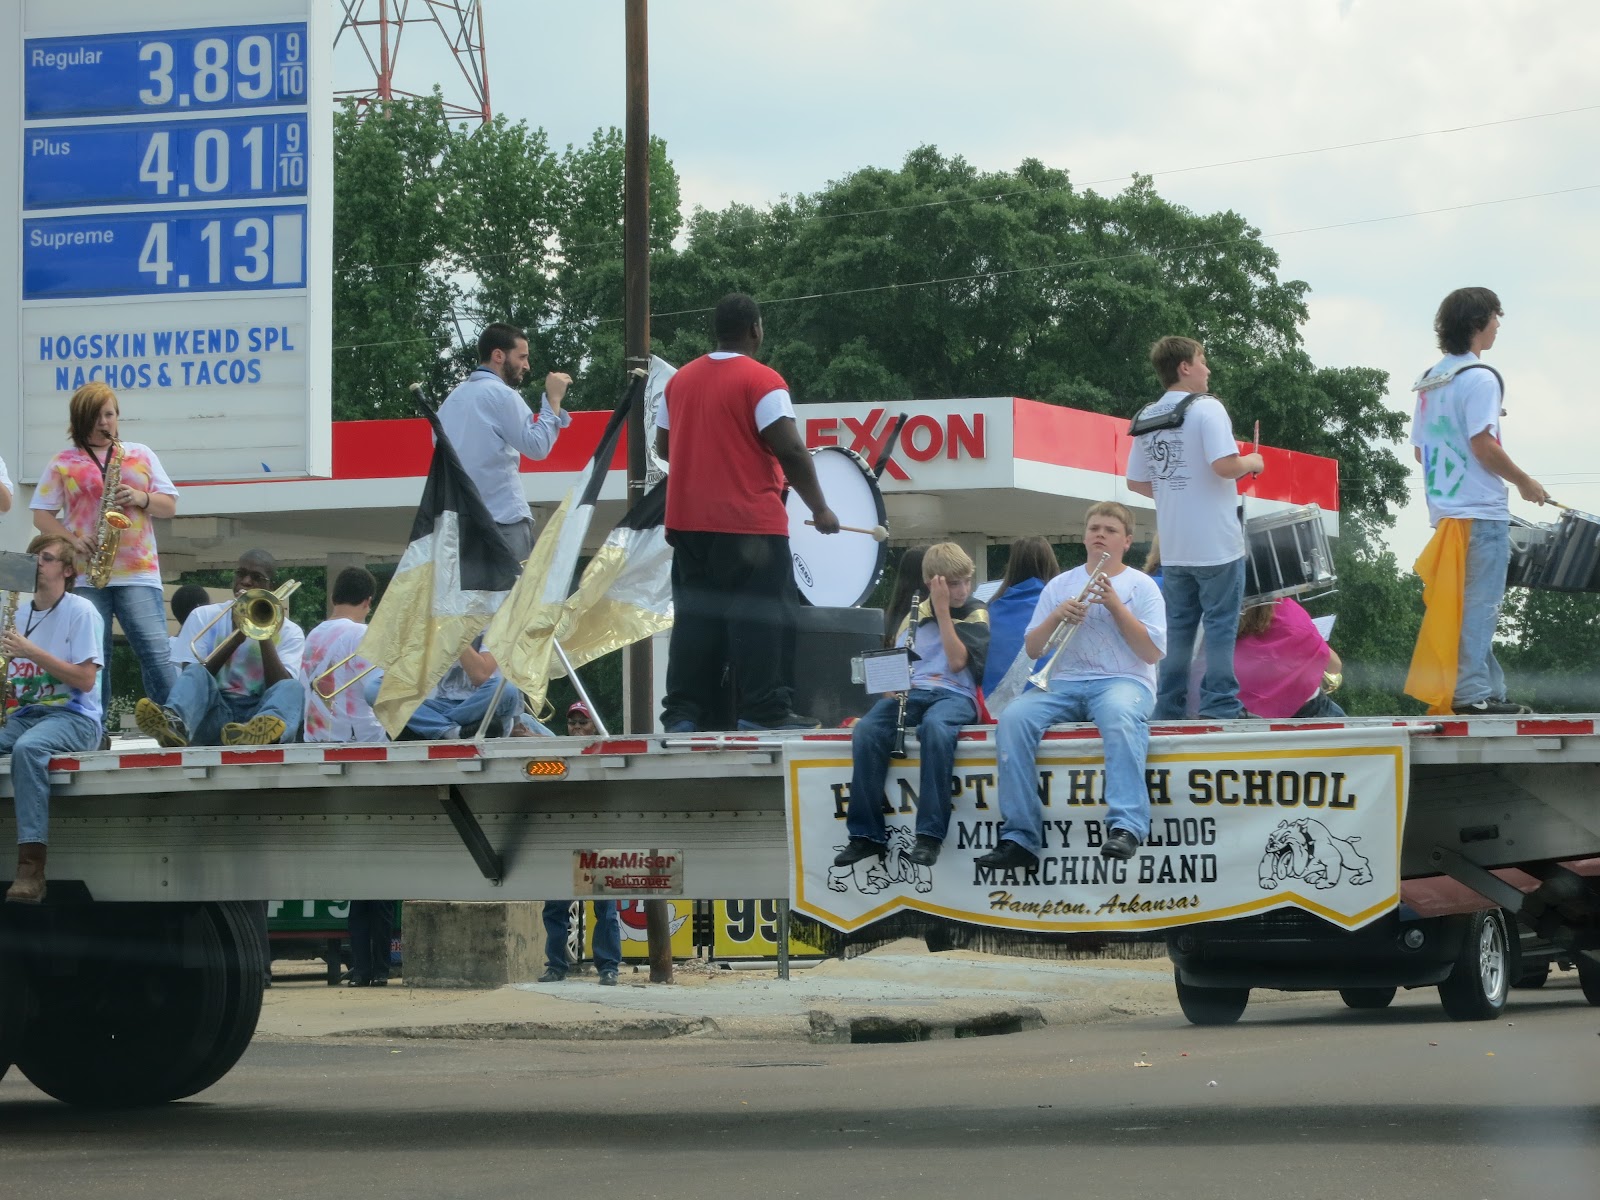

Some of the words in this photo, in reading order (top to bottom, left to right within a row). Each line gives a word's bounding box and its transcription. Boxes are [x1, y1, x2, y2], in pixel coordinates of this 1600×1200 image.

[32, 47, 103, 70] Regular
[139, 35, 273, 106] 3.89
[32, 138, 71, 157] Plus
[139, 126, 264, 197] 4.01
[30, 228, 114, 250] Supreme
[138, 217, 269, 288] 4.13
[40, 332, 147, 361] HOGSKIN
[153, 329, 240, 356] WKEND
[248, 326, 295, 353] SPL
[56, 363, 151, 391] NACHOS
[157, 362, 172, 387] &
[181, 358, 262, 386] TACOS
[805, 408, 987, 481] EXXON
[1066, 769, 1174, 808] HH
[1188, 769, 1357, 811] SCHOOL
[957, 820, 1073, 850] MITY
[1084, 816, 1217, 849] BLDOG
[579, 852, 676, 869] MaxMiser
[1137, 853, 1218, 884] BAND
[583, 872, 597, 885] by
[1095, 892, 1202, 916] Arkansas
